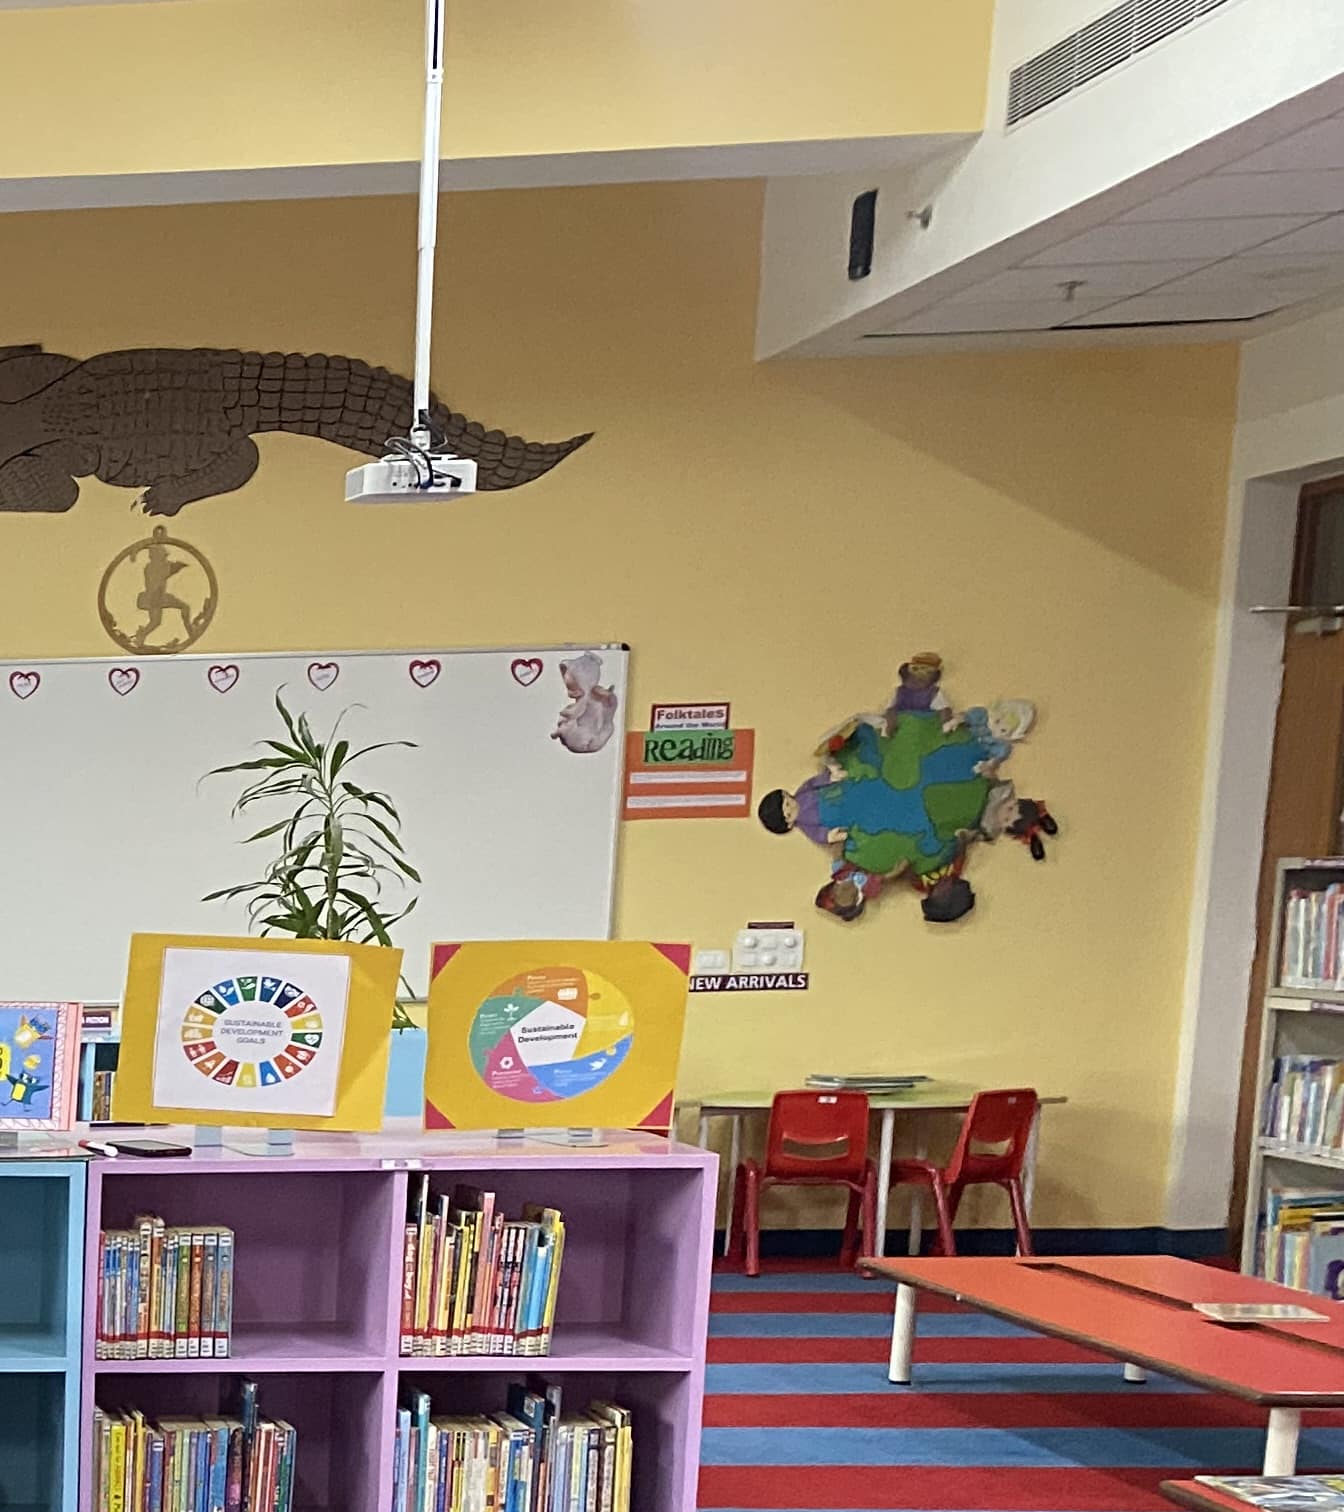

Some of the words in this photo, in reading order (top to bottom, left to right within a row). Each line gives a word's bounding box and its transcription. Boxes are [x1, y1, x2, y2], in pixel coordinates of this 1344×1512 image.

[656, 708, 725, 720] Folktales
[643, 732, 734, 763] Reading
[725, 973, 807, 989] ARRIVALS
[223, 1019, 282, 1028] SUSTAINABLE
[521, 1023, 575, 1034] Sustainable
[220, 1028, 284, 1037] DEVELOPMENT
[518, 1031, 578, 1044] Development
